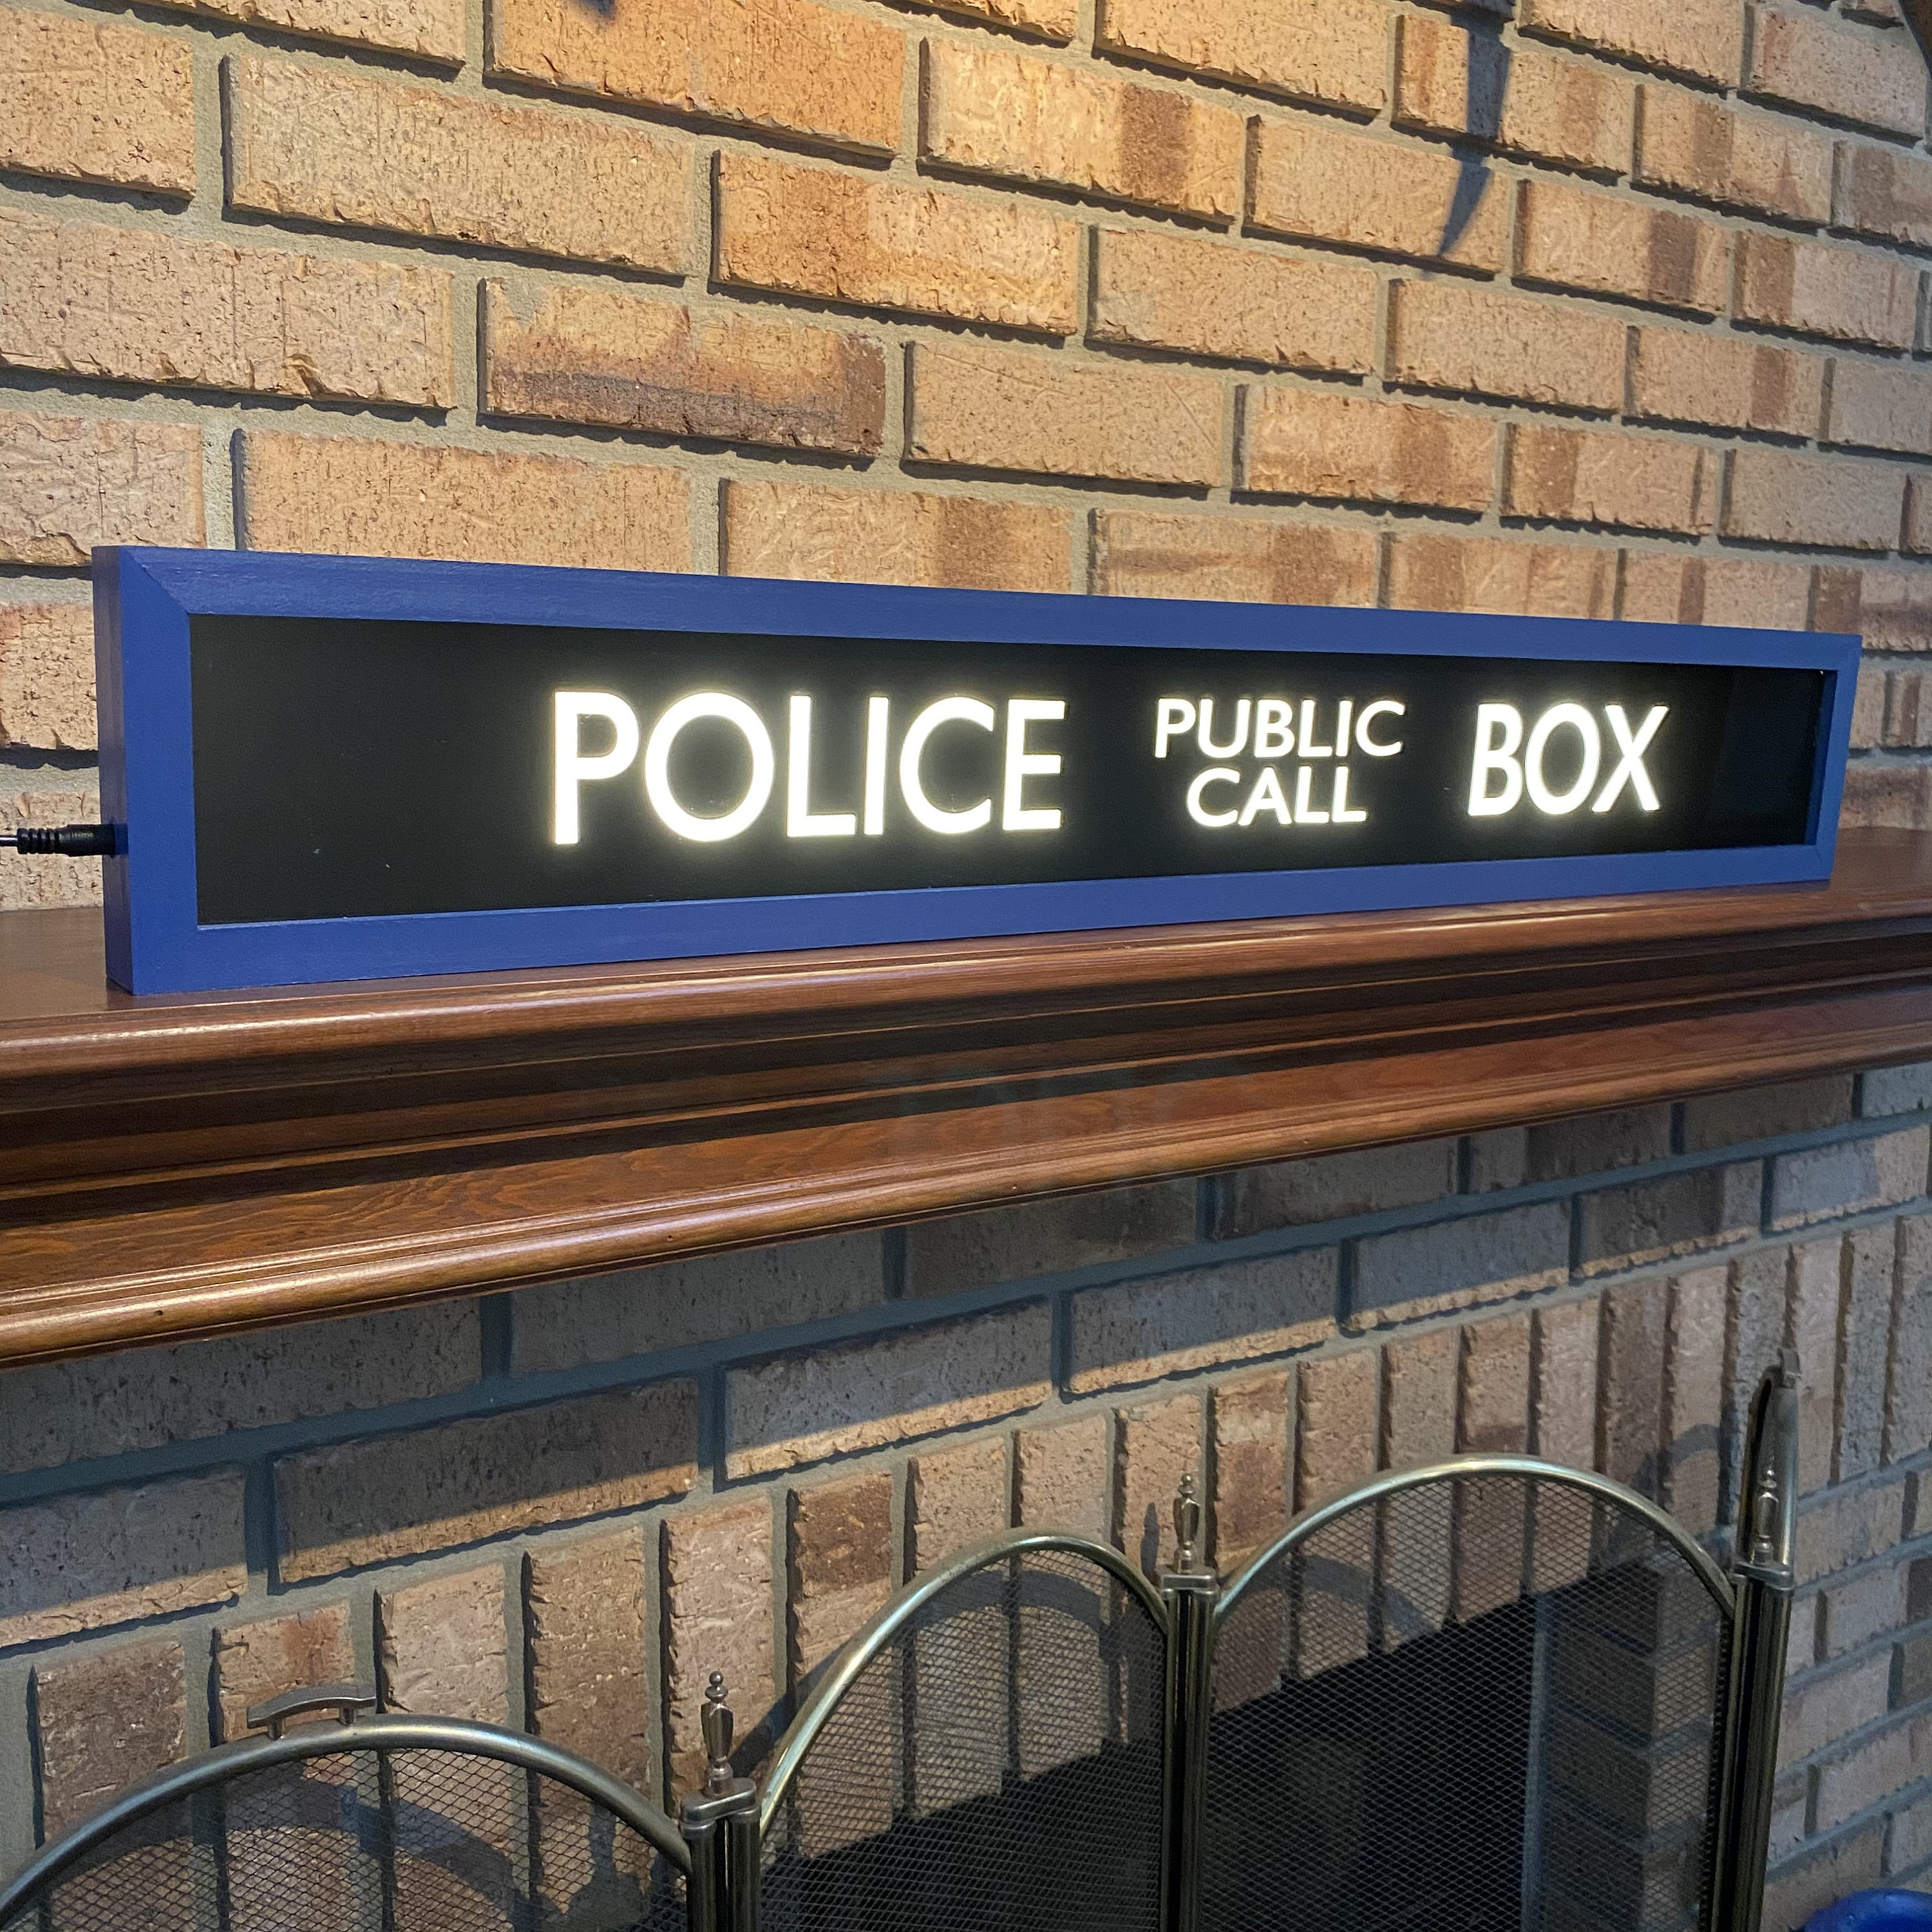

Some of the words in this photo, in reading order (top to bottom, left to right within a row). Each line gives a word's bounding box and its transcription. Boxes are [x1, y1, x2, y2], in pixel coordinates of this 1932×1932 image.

[553, 689, 1066, 845] POLICE
[1154, 699, 1406, 759] PUBLIC
[1468, 703, 1669, 817] BOX
[1186, 766, 1367, 828] CALL
